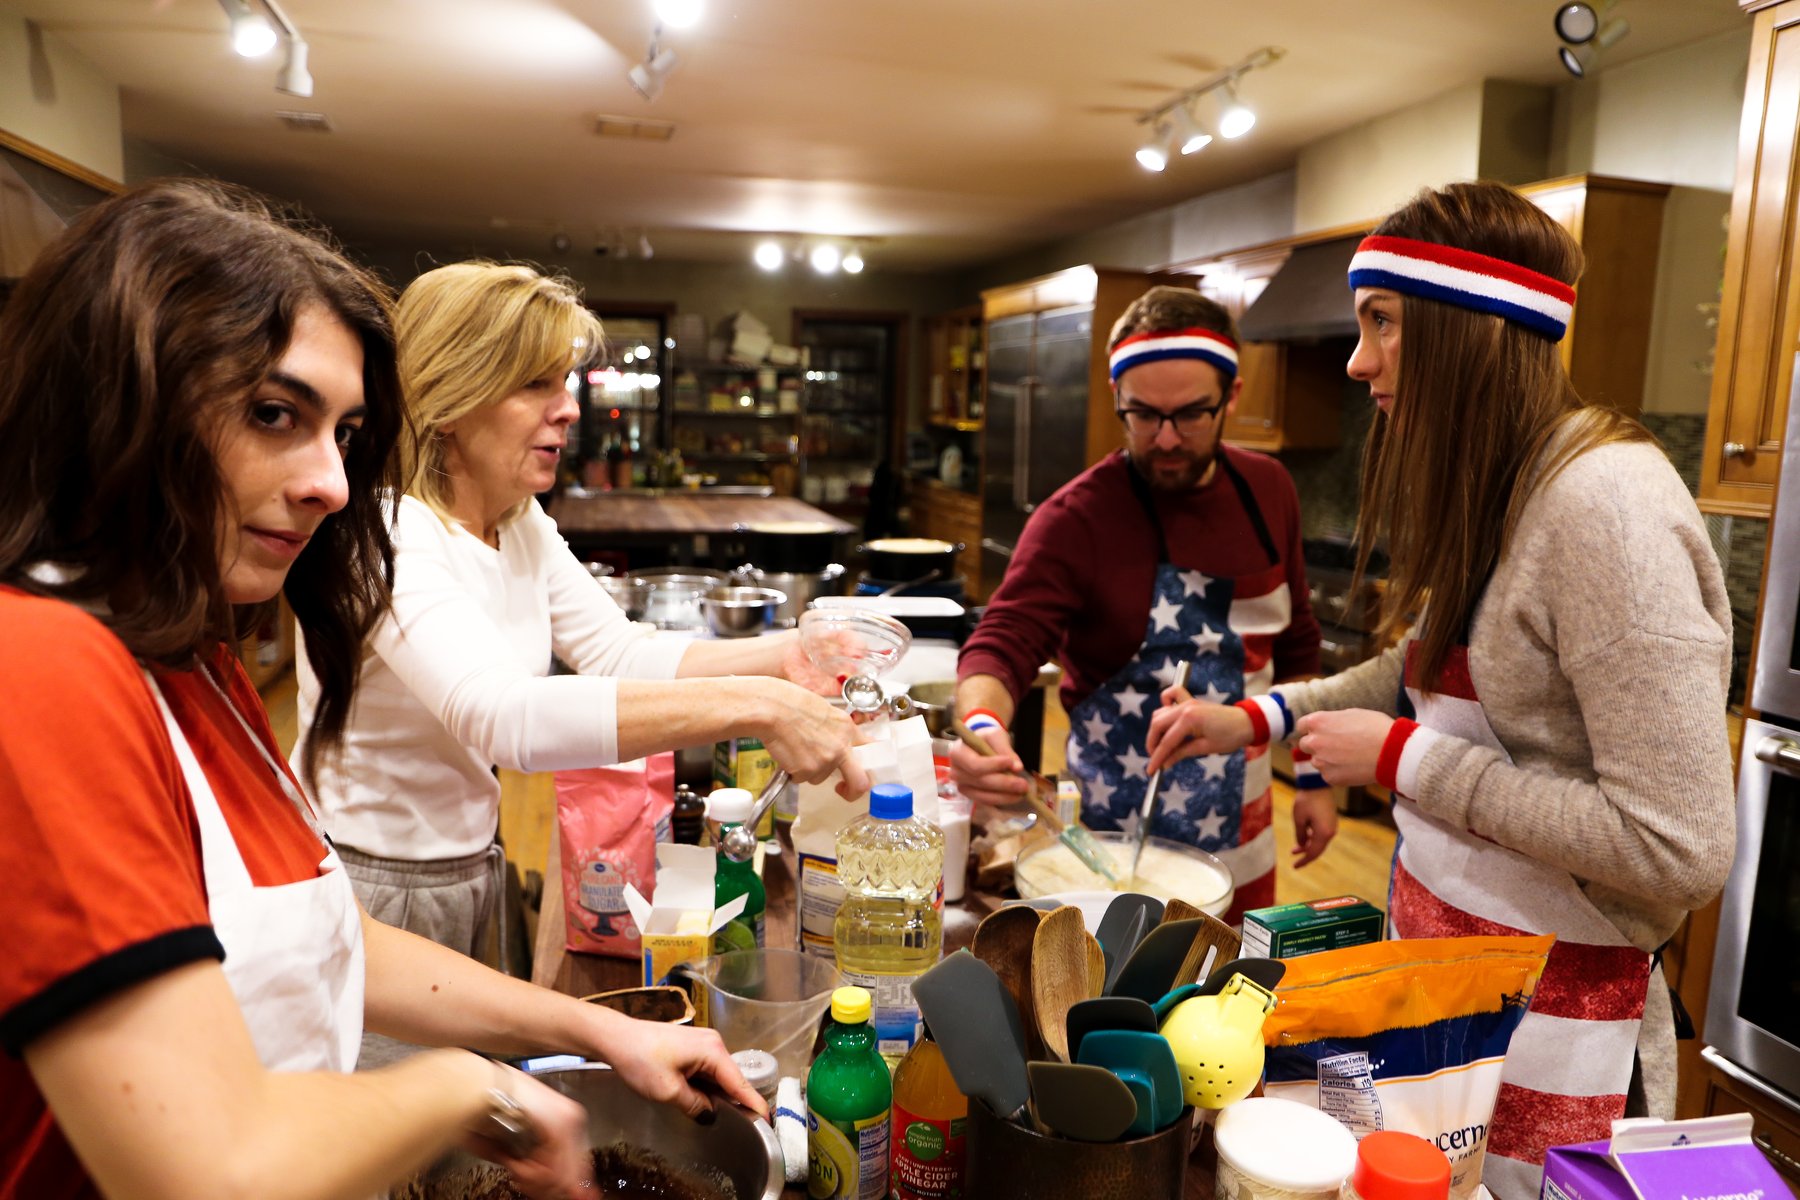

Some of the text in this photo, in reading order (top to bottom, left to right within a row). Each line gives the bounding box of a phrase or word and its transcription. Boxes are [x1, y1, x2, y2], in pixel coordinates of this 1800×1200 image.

[580, 882, 626, 897] GRANULATE
[1321, 1059, 1349, 1070] Nutrition
[1348, 1055, 1365, 1065] Facts
[1322, 1079, 1356, 1088] Calories
[908, 1136, 942, 1150] organic
[895, 1157, 959, 1181] APPLE CIDER
[912, 1161, 952, 1172] UNFILTERED
[901, 1169, 947, 1189] VINEGAR
[916, 1189, 942, 1198] MOTHER
